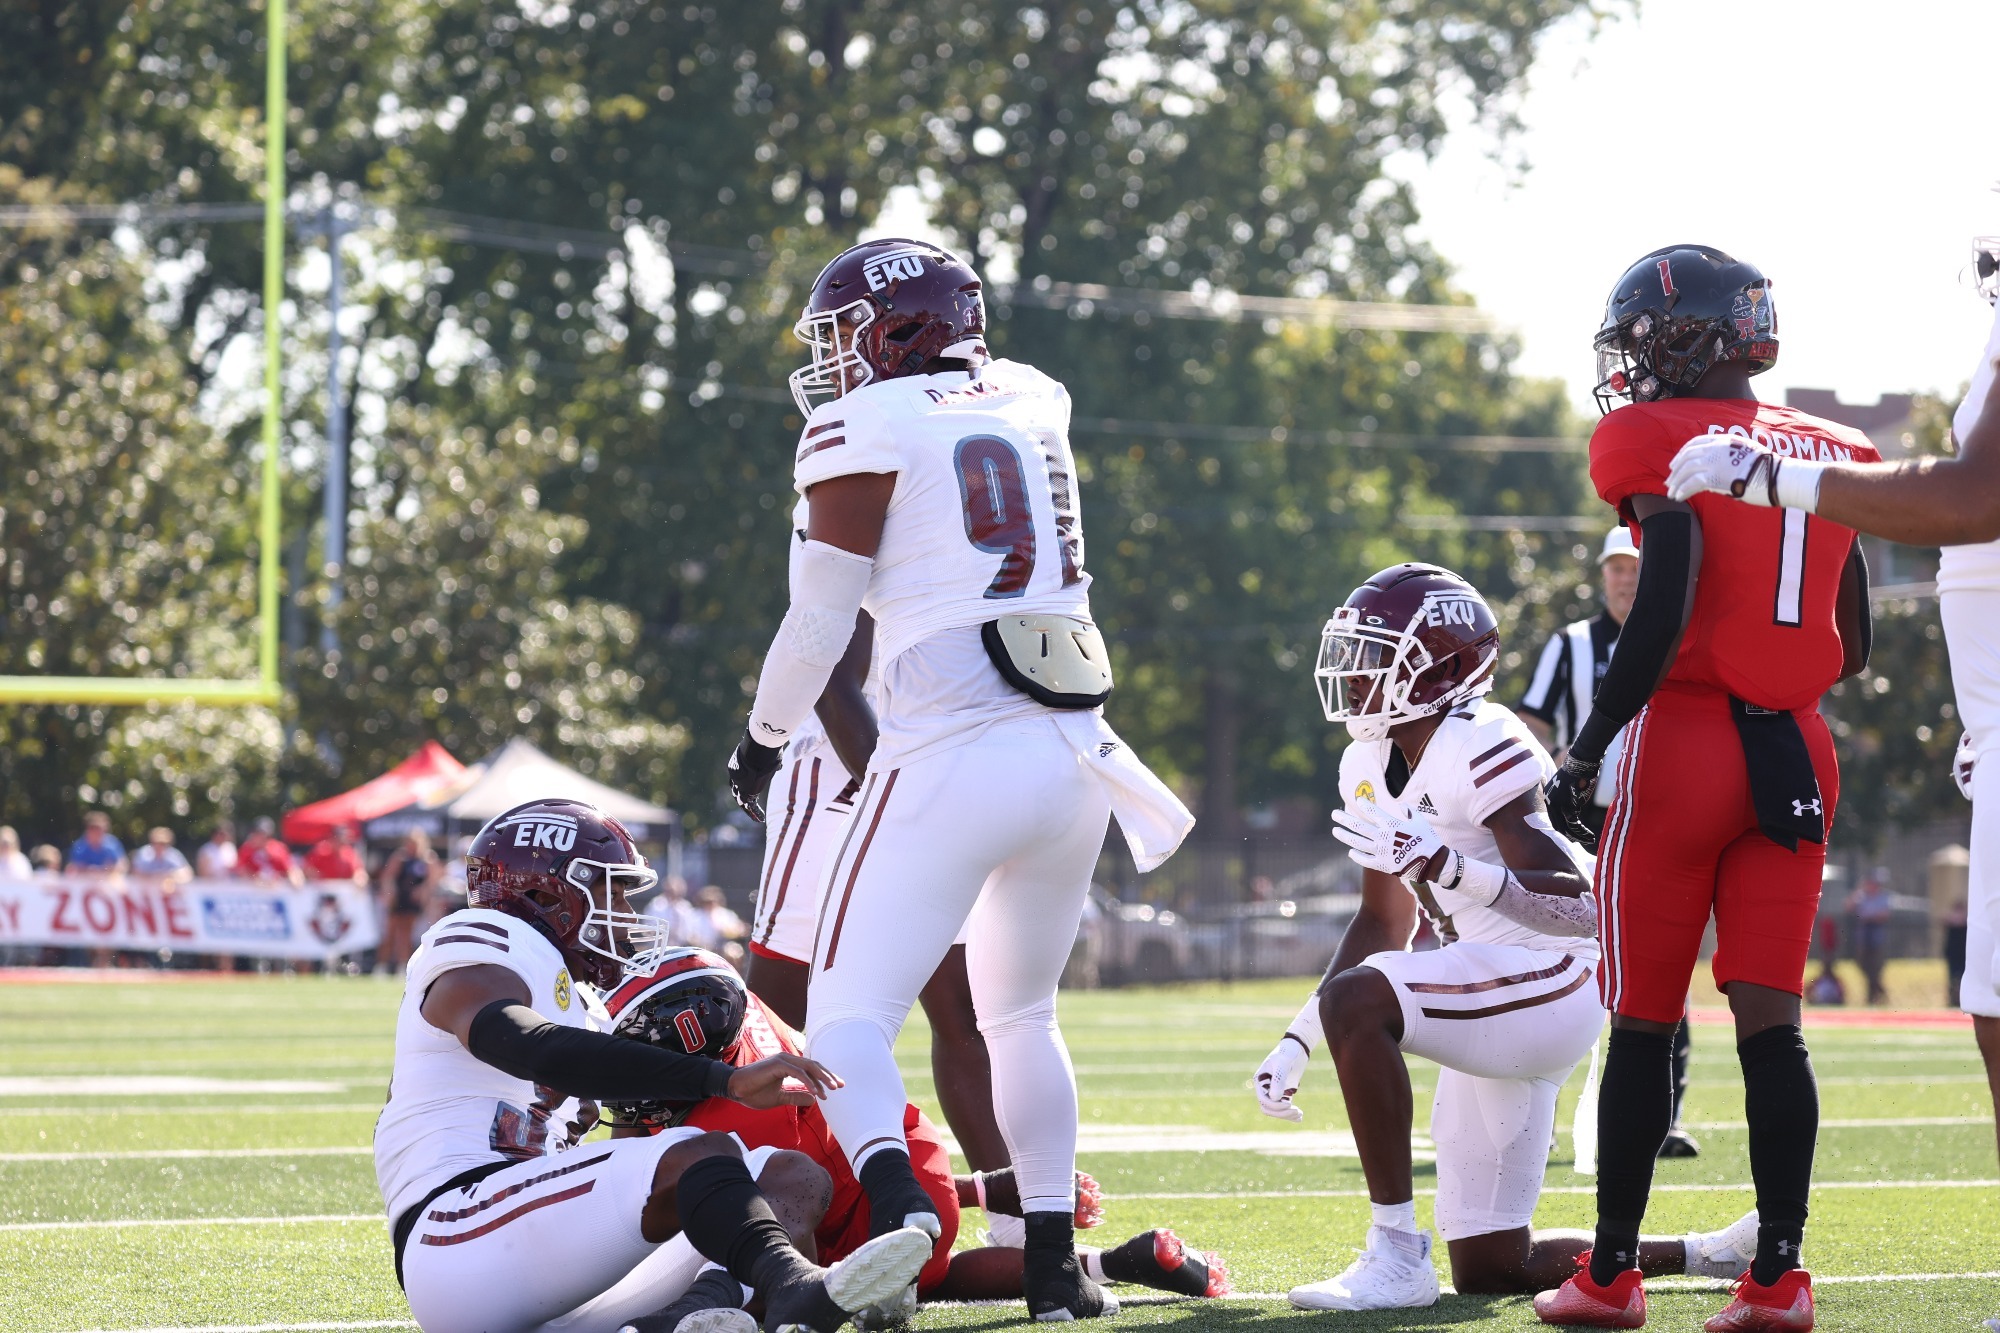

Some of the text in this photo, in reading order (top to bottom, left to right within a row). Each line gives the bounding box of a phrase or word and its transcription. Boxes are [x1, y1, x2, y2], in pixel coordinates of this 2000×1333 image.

[864, 256, 924, 292] EKU
[1656, 259, 1674, 296] 1
[1426, 600, 1475, 627] EKU
[1417, 805, 1439, 816] adidas
[513, 823, 578, 852] EKU
[1394, 835, 1423, 864] adidas
[50, 888, 194, 937] ZONE
